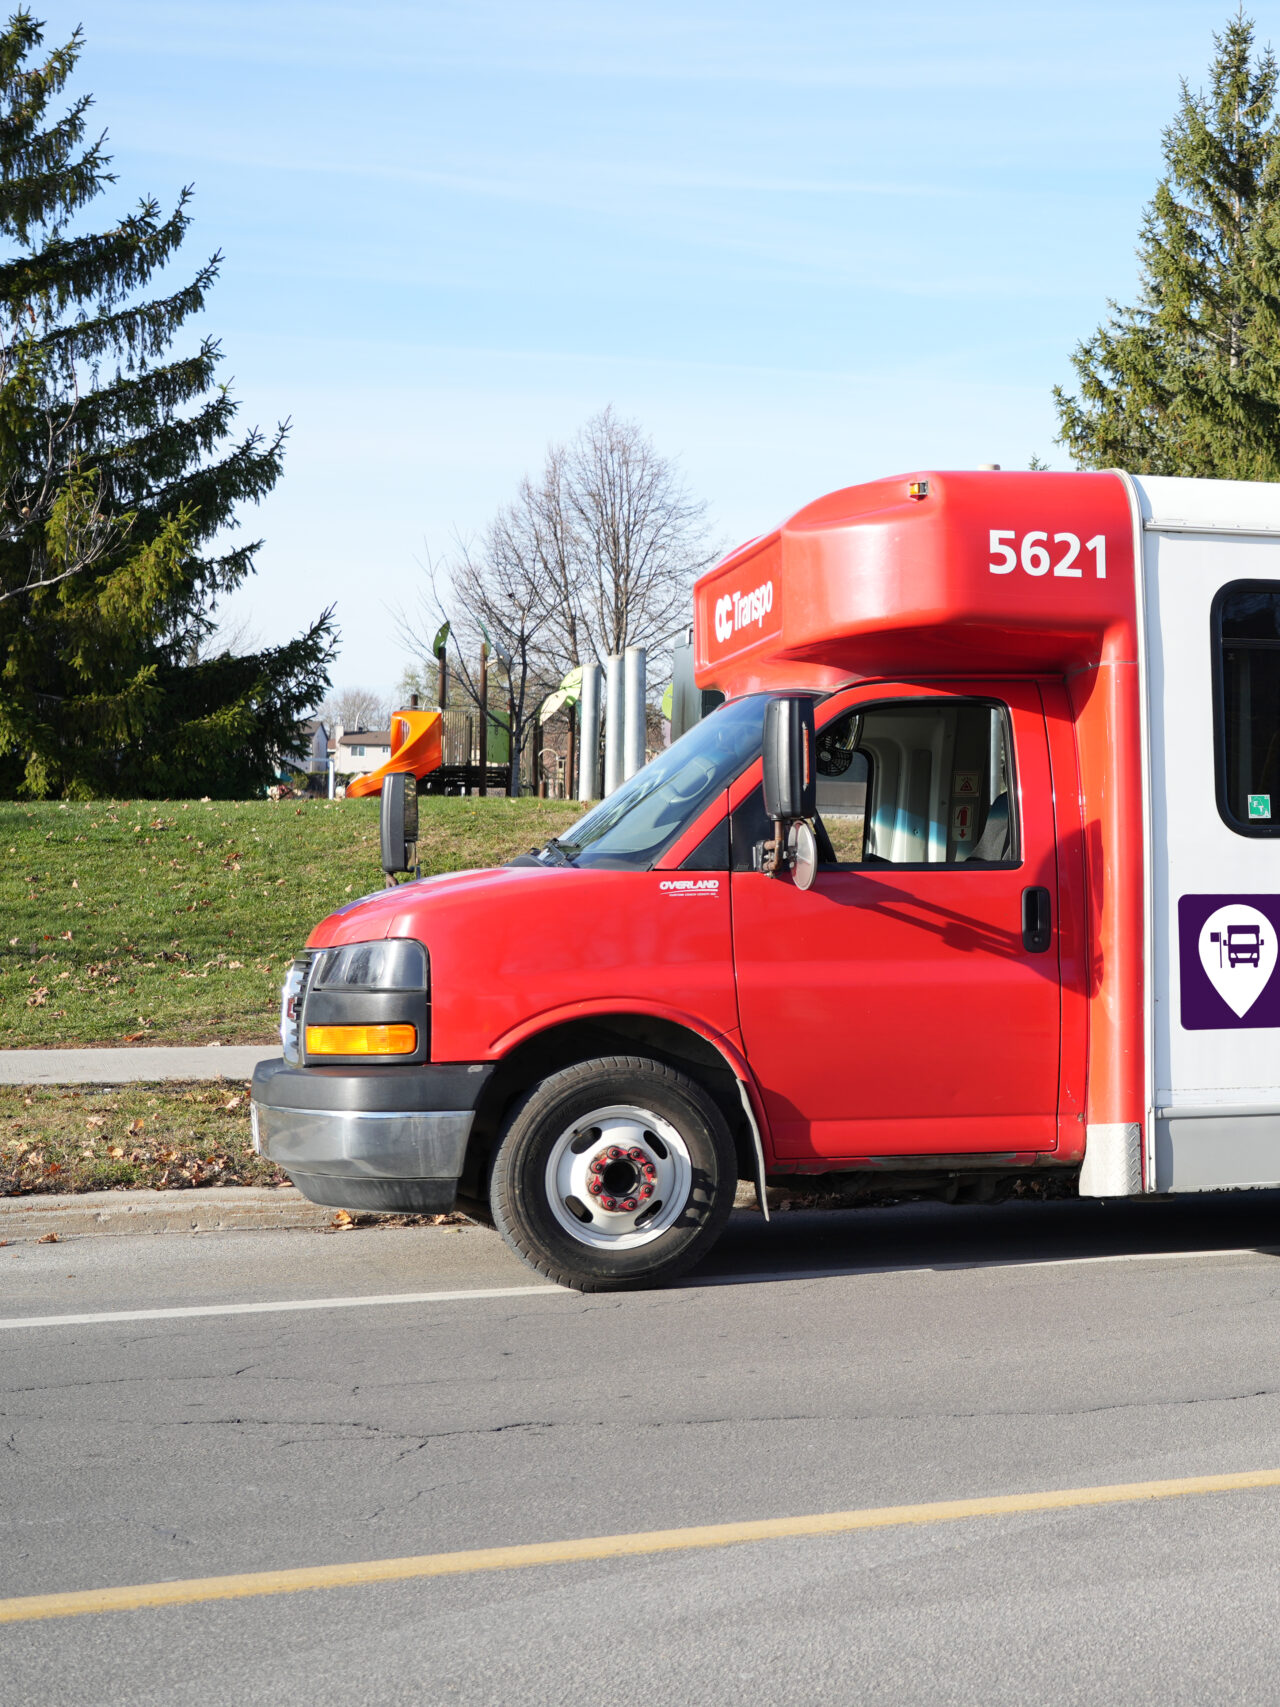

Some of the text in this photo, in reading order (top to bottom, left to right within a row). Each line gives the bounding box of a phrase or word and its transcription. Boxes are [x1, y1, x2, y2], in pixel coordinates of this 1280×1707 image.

[988, 529, 1107, 579] 5621
[715, 580, 773, 643] OC Transpo
[659, 880, 719, 890] OVERLAND
